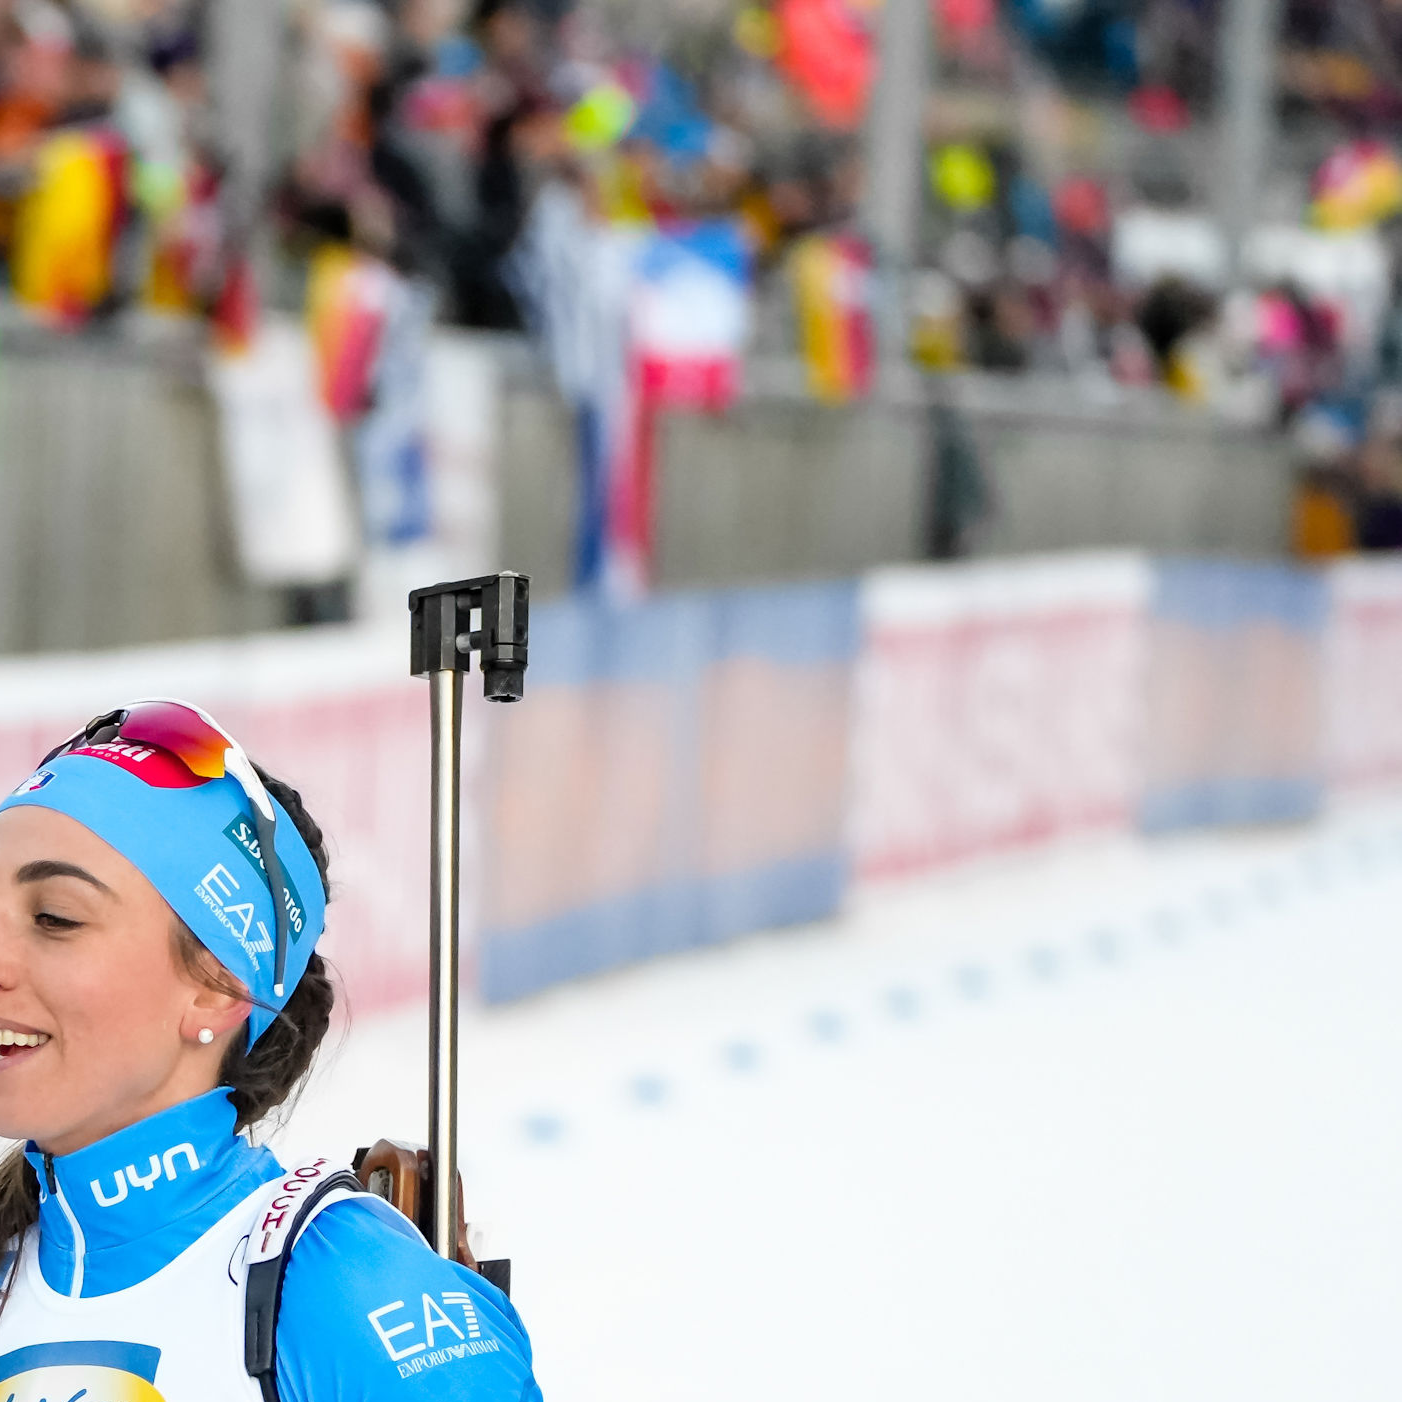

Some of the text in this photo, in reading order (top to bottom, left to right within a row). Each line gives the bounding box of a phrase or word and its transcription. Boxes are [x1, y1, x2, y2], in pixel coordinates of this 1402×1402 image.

[201, 862, 275, 953] EA7
[367, 1291, 482, 1362] EA7
[396, 1346, 453, 1379] EMPORIO
